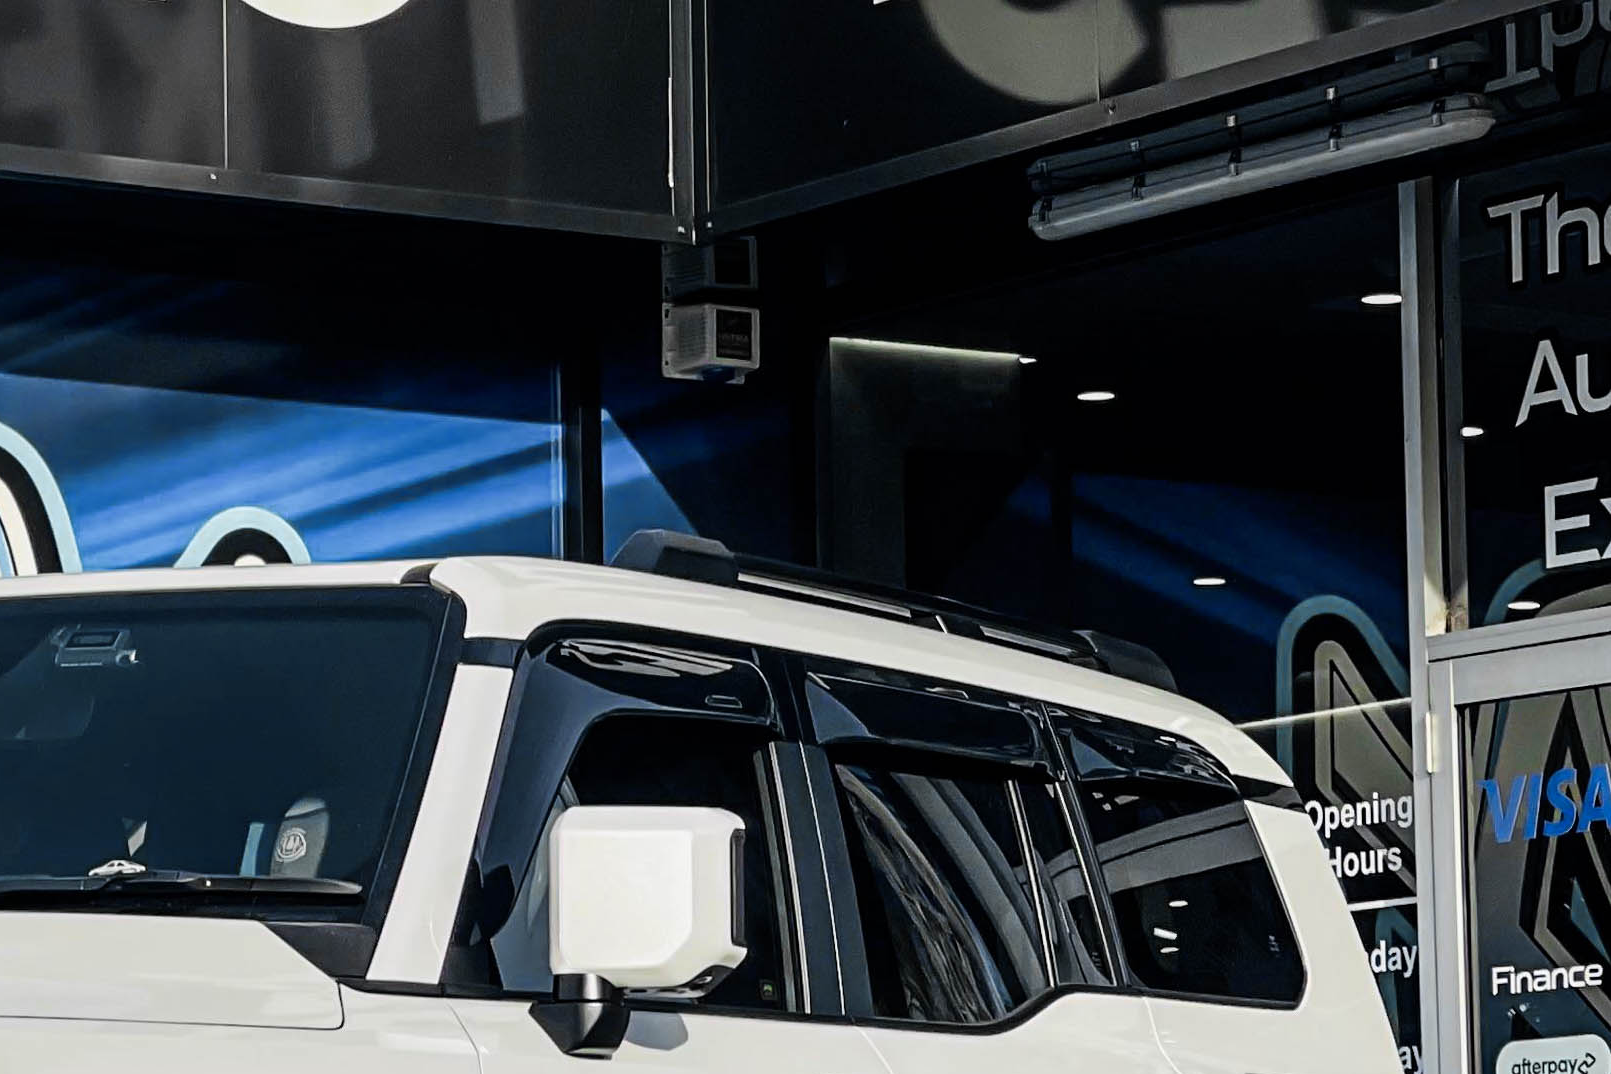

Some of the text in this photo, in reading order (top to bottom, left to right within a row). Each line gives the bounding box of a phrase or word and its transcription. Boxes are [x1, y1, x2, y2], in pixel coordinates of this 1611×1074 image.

[1487, 192, 1611, 283] Th
[1305, 792, 1413, 838] Opening
[1477, 764, 1611, 843] VISA
[1370, 940, 1417, 977] day
[1491, 962, 1603, 996] Finance
